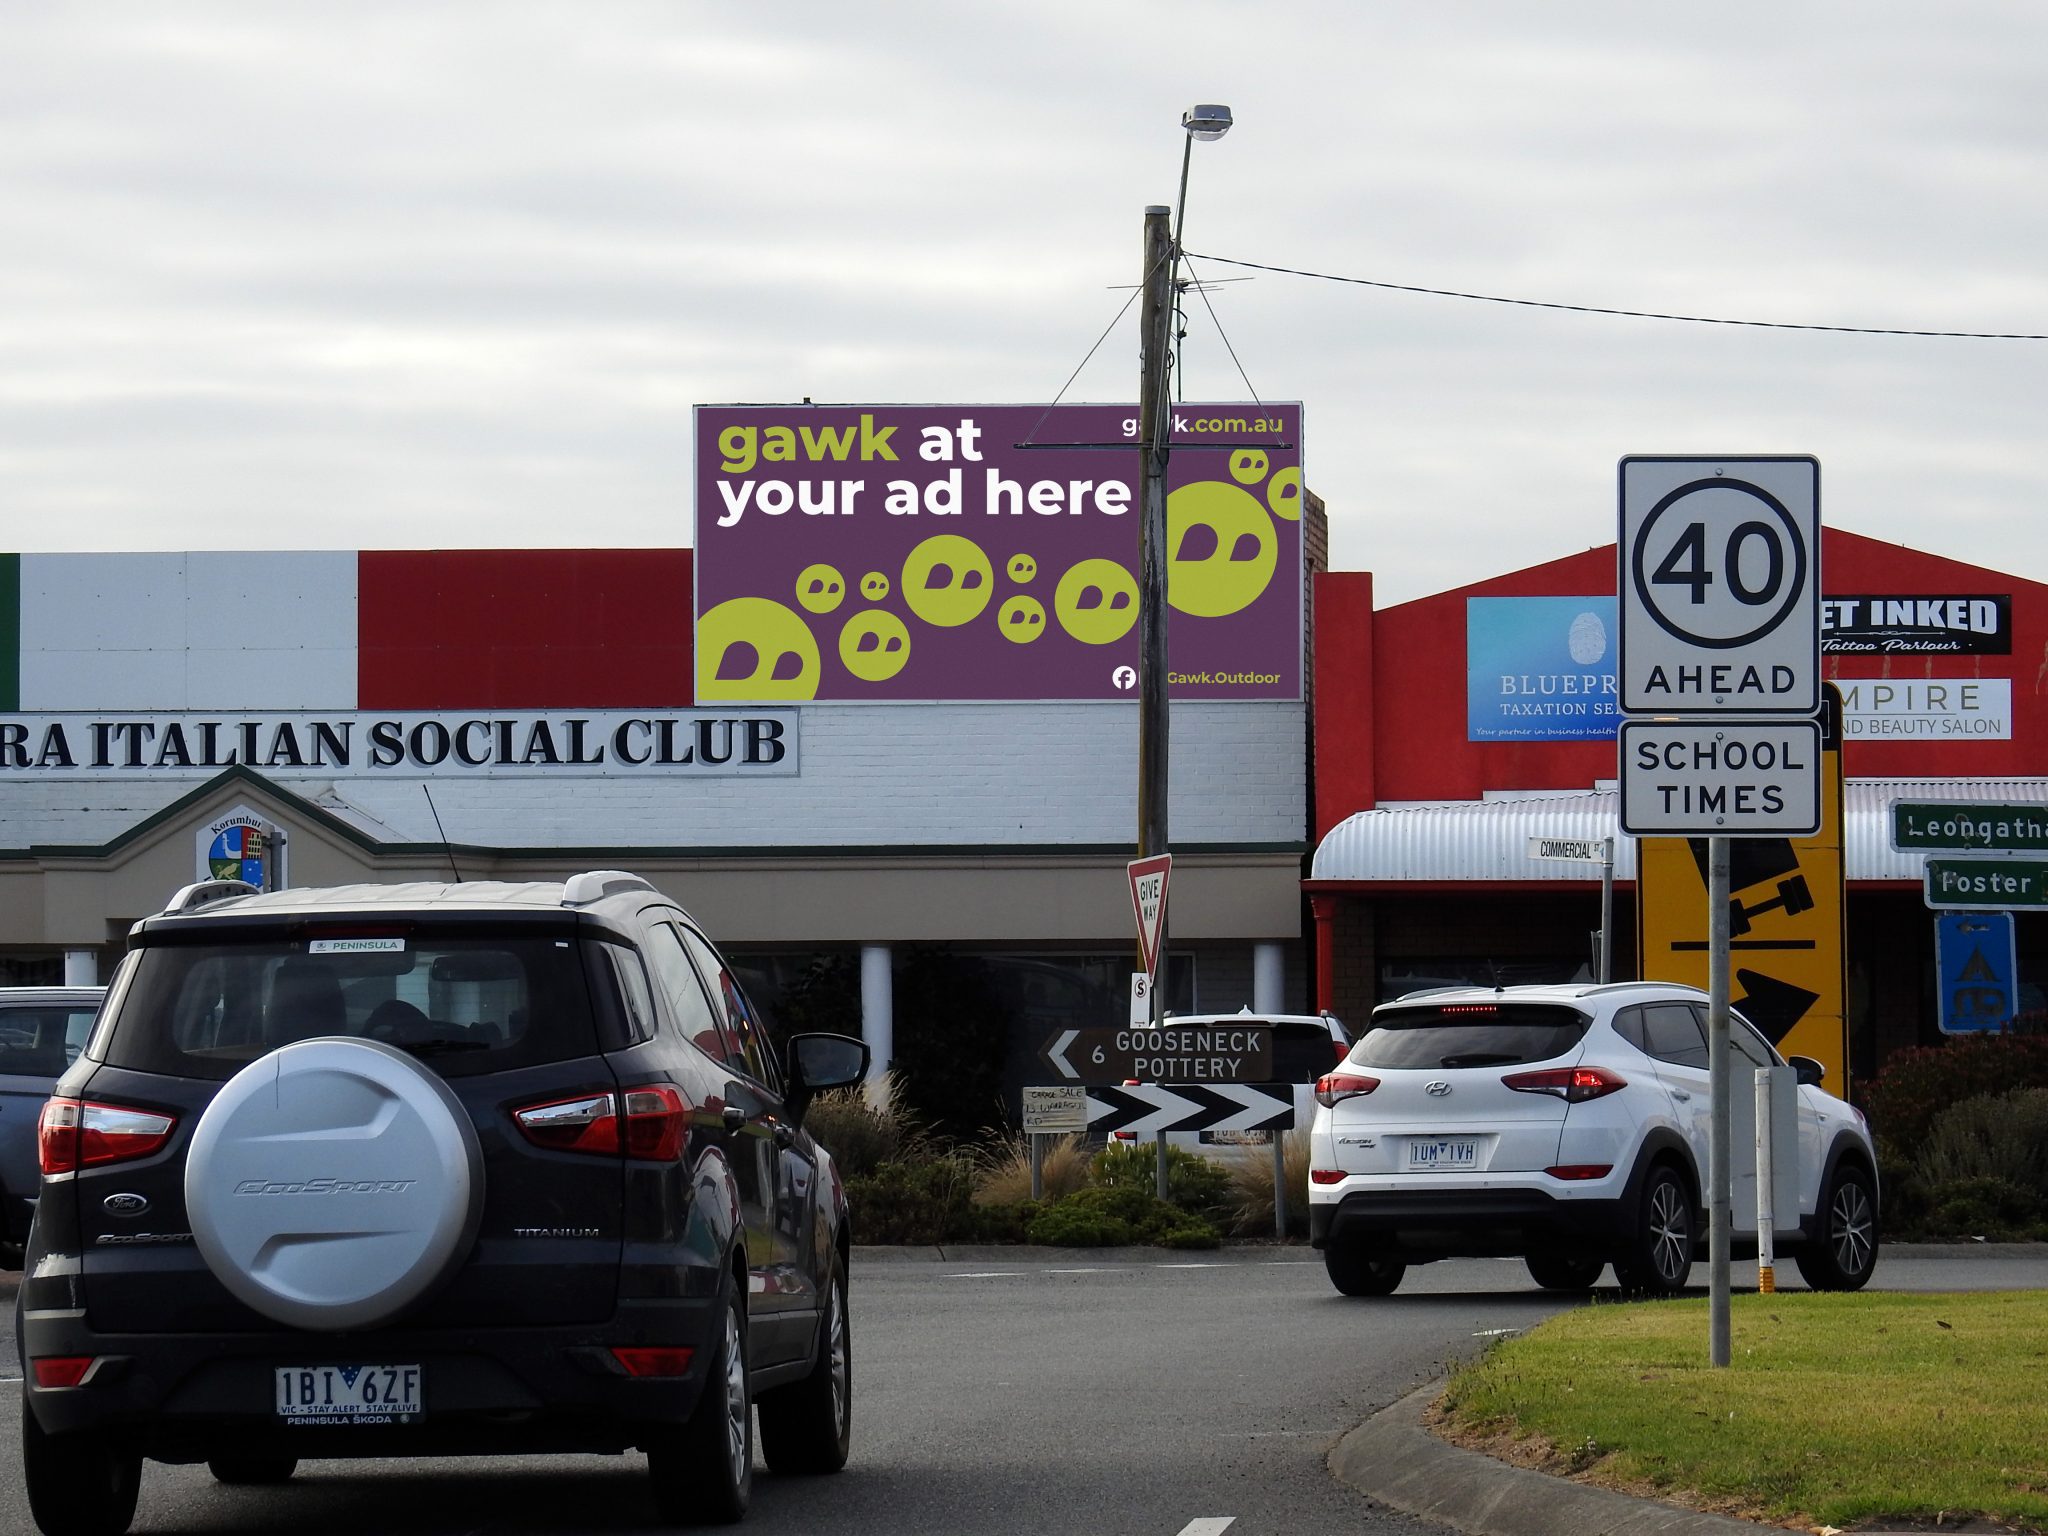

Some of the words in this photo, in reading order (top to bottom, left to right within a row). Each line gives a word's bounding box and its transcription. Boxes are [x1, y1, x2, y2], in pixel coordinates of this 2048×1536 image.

[1122, 414, 1283, 437] gk.com.au
[718, 414, 900, 474] gawk
[919, 419, 984, 462] at
[716, 480, 865, 528] your
[884, 468, 963, 516] ad
[986, 468, 1132, 516] here
[1651, 521, 1784, 606] 40
[1871, 601, 1998, 635] INKED
[1822, 639, 1878, 652] Tattoo
[1881, 639, 1961, 651] Parlour
[1168, 671, 1281, 684] Gawk.Outdoor
[1500, 675, 1618, 695] BLUEPR
[1644, 665, 1795, 694] AHEAD
[1500, 703, 1587, 716] TAXATION
[1476, 726, 1497, 736] Your
[1498, 726, 1532, 737] partner
[1534, 727, 1546, 735] in
[1547, 726, 1585, 737] business
[1870, 719, 1937, 734] BEAUTY
[1942, 719, 2001, 734] SALON
[0, 722, 80, 768] RA
[88, 721, 355, 768] ITALIAN
[368, 720, 605, 767] SOCIAL
[611, 719, 786, 766] CLUB
[1637, 741, 1804, 771] SCHOOL
[1657, 785, 1785, 815] TIMES
[210, 815, 262, 835] Korumbur
[1540, 841, 1592, 859] COMMERCIAL
[1140, 878, 1159, 901] GIVE
[1941, 871, 2032, 894] Foster
[1143, 904, 1157, 922] WAY
[333, 941, 398, 950] PENINSULA
[1116, 1031, 1260, 1052] GOOSENECK
[1092, 1046, 1106, 1064] 6
[1134, 1057, 1242, 1078] POTTERY
[1059, 1087, 1084, 1098] SALE
[1414, 1144, 1438, 1161] 1UM
[1450, 1144, 1474, 1160] 1VH
[514, 1228, 599, 1237] TITANIUM
[283, 1371, 334, 1406] 1BI
[362, 1370, 418, 1404] 6ZF
[281, 1405, 297, 1414] VIC
[307, 1405, 330, 1414] STAY
[332, 1404, 361, 1413] ALERT
[365, 1404, 390, 1413] STAY
[391, 1403, 418, 1412] ALIVE
[287, 1416, 350, 1425] PENINSULA
